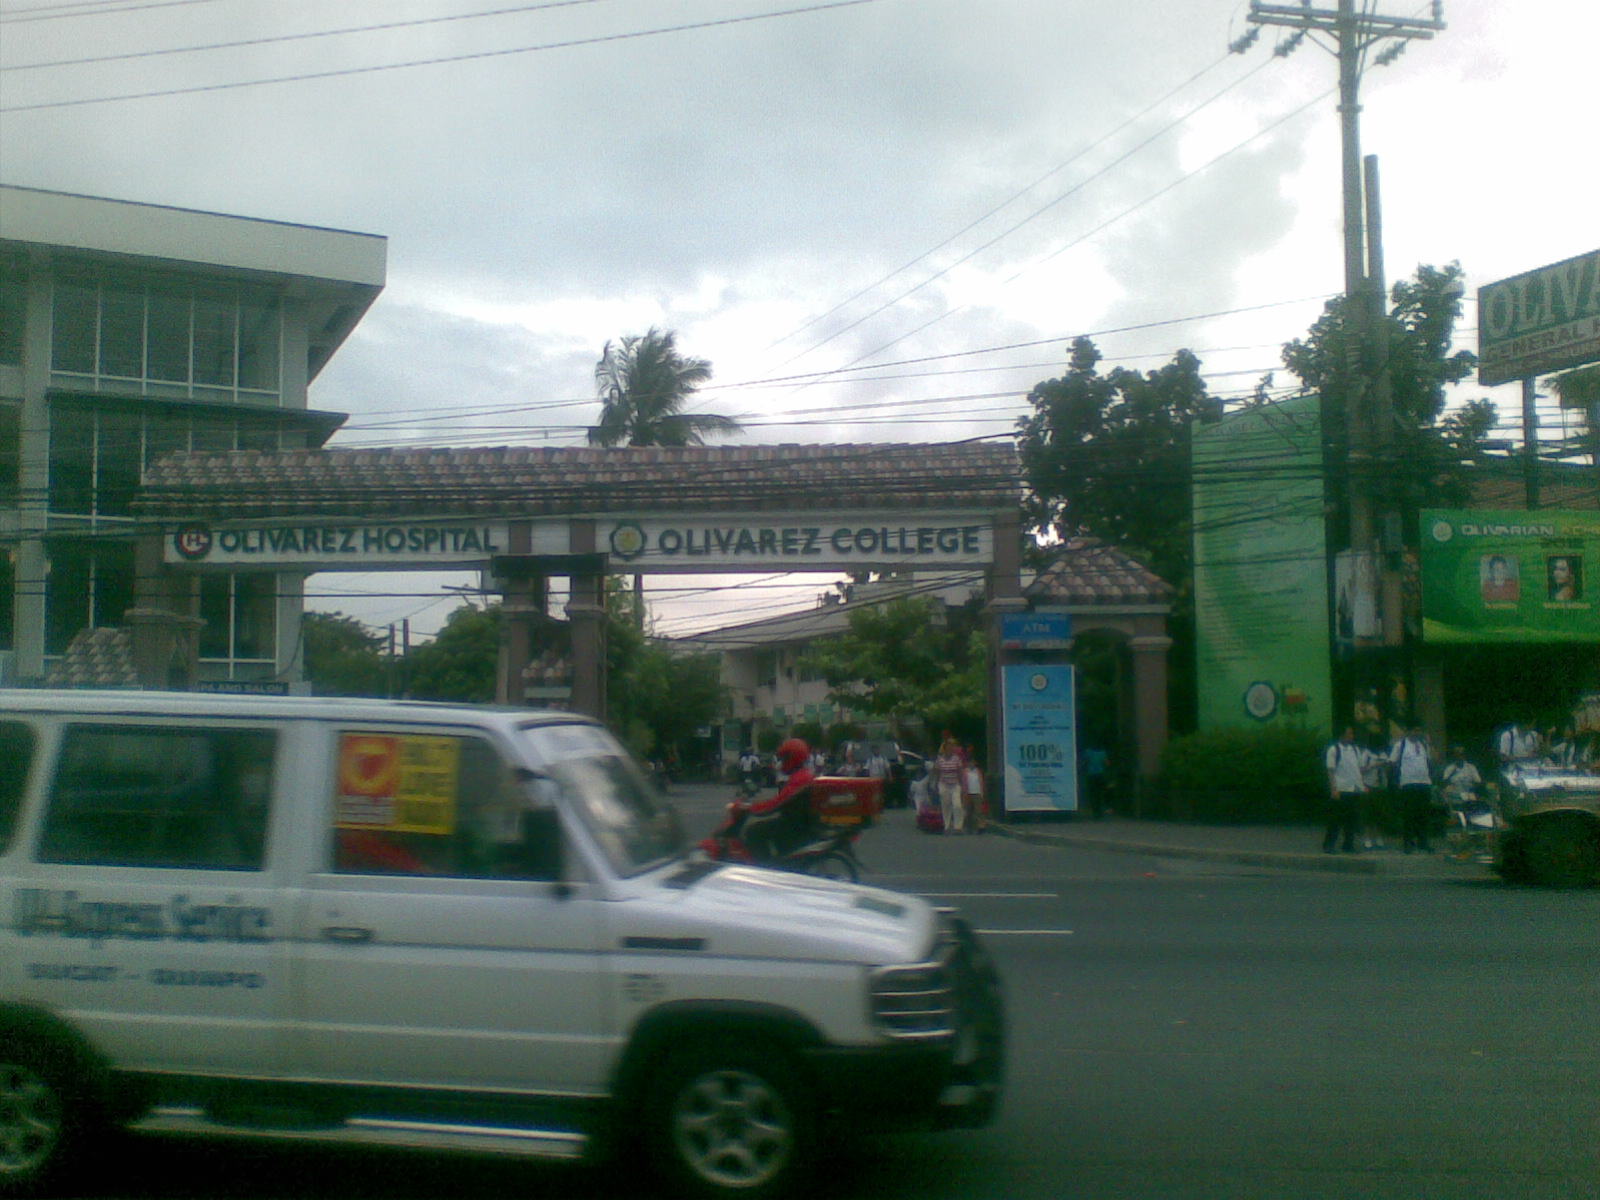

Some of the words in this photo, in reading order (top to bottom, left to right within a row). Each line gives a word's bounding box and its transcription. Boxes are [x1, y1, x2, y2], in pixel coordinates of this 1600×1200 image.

[220, 528, 355, 553] OLIVAREZ
[364, 526, 498, 552] HOSPITAL
[1461, 524, 1554, 536] OLIVARIAN
[659, 528, 821, 556] OLIVAREZ
[832, 528, 980, 553] COLLEGE
[1019, 744, 1064, 761] 100%
